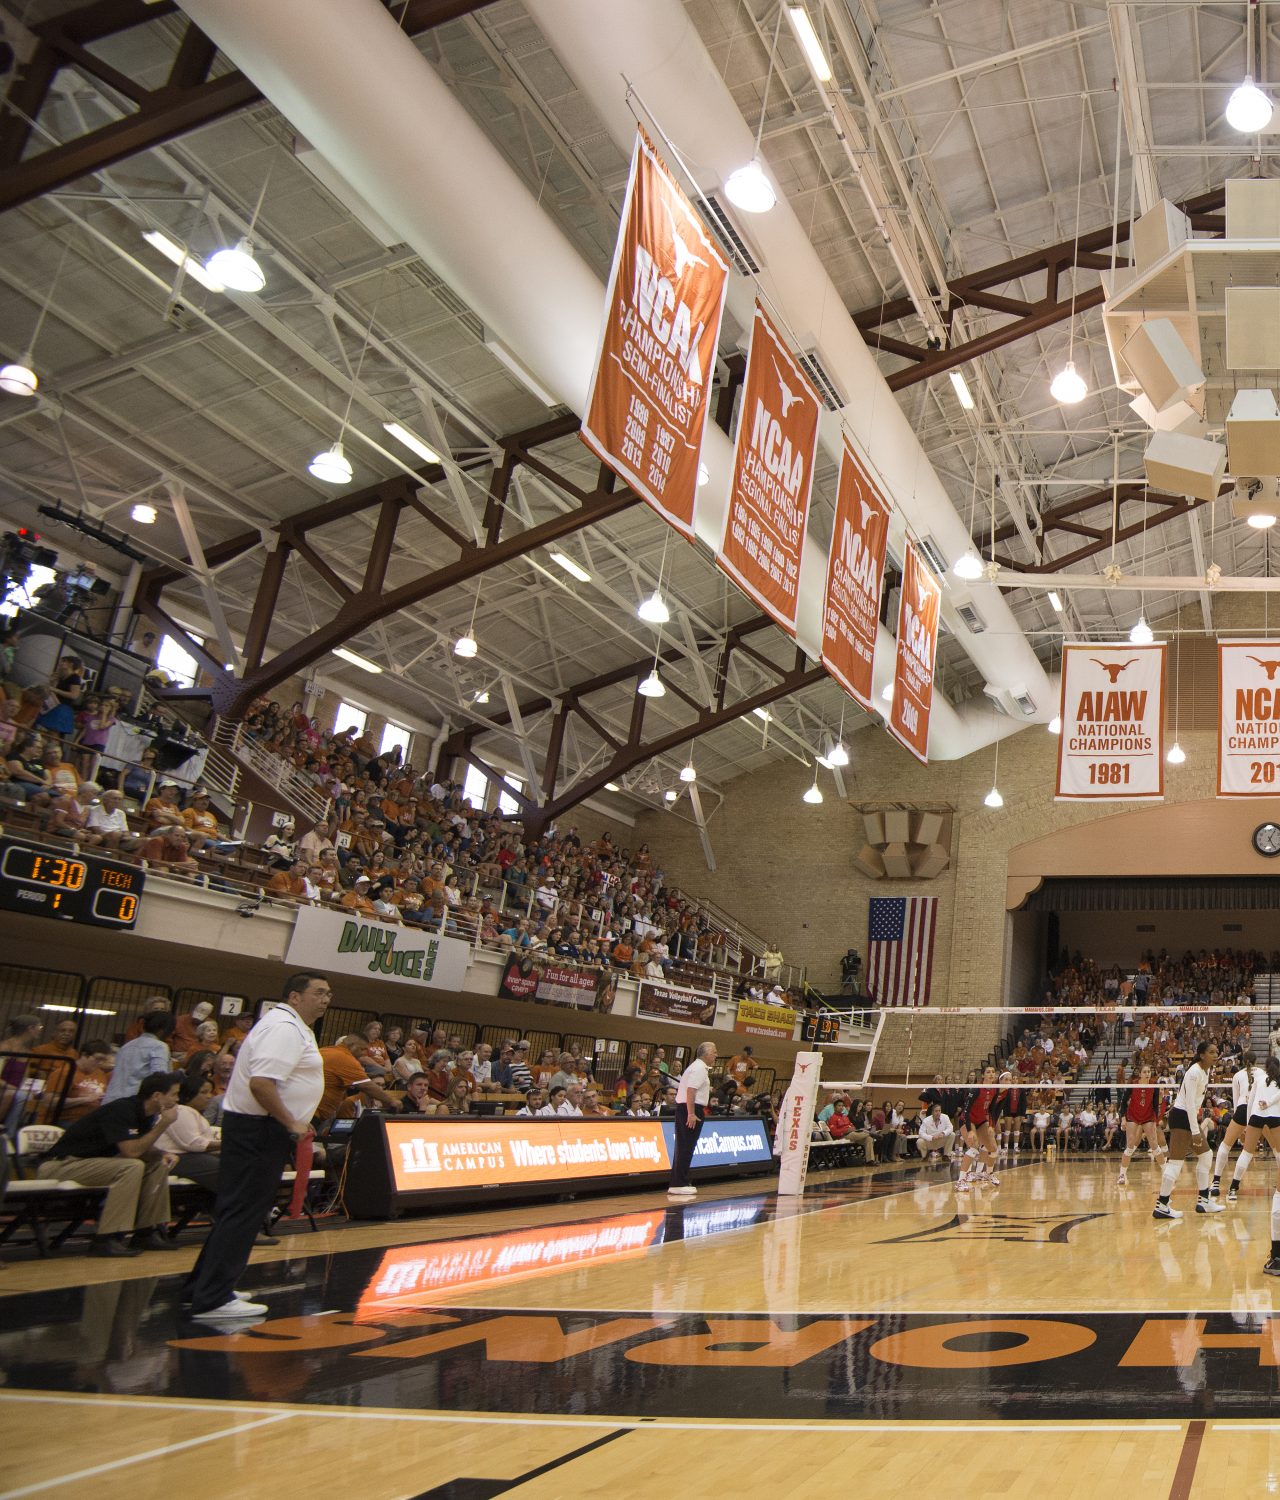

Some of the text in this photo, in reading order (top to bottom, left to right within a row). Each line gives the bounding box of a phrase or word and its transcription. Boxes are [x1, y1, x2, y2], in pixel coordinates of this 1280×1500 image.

[620, 299, 700, 412] CHAMPIONSHI
[622, 341, 693, 429] SEMI-FINALIST
[751, 397, 804, 504] NCAA
[621, 436, 667, 496] 2013 2014
[740, 467, 772, 520] REGIONAL
[840, 517, 877, 603] NCAA
[1076, 691, 1148, 722] AIAW
[1069, 737, 1152, 751] CHAMPIONS
[1078, 723, 1145, 737] NATIONAL
[1088, 763, 1130, 785] 1981
[32, 857, 85, 889] 1:30
[101, 869, 133, 889] TECH
[119, 895, 136, 920] 0
[338, 920, 397, 952] DAILY
[368, 950, 425, 979] JUICE
[423, 939, 439, 981] CAFE
[546, 969, 594, 987] Fun for all ages
[228, 1003, 235, 1014] 2
[654, 989, 668, 998] Texas
[669, 992, 692, 1003] Volleyball
[692, 997, 708, 1006] Camps
[740, 1004, 766, 1020] TACO
[789, 1095, 804, 1151] TEXAS
[442, 1141, 502, 1156] AMERICAN
[509, 1139, 556, 1167] Where
[557, 1137, 608, 1165] students
[606, 1137, 631, 1161] love
[693, 1132, 763, 1157] ricanCampus.com
[444, 1156, 505, 1171] CAMPUS
